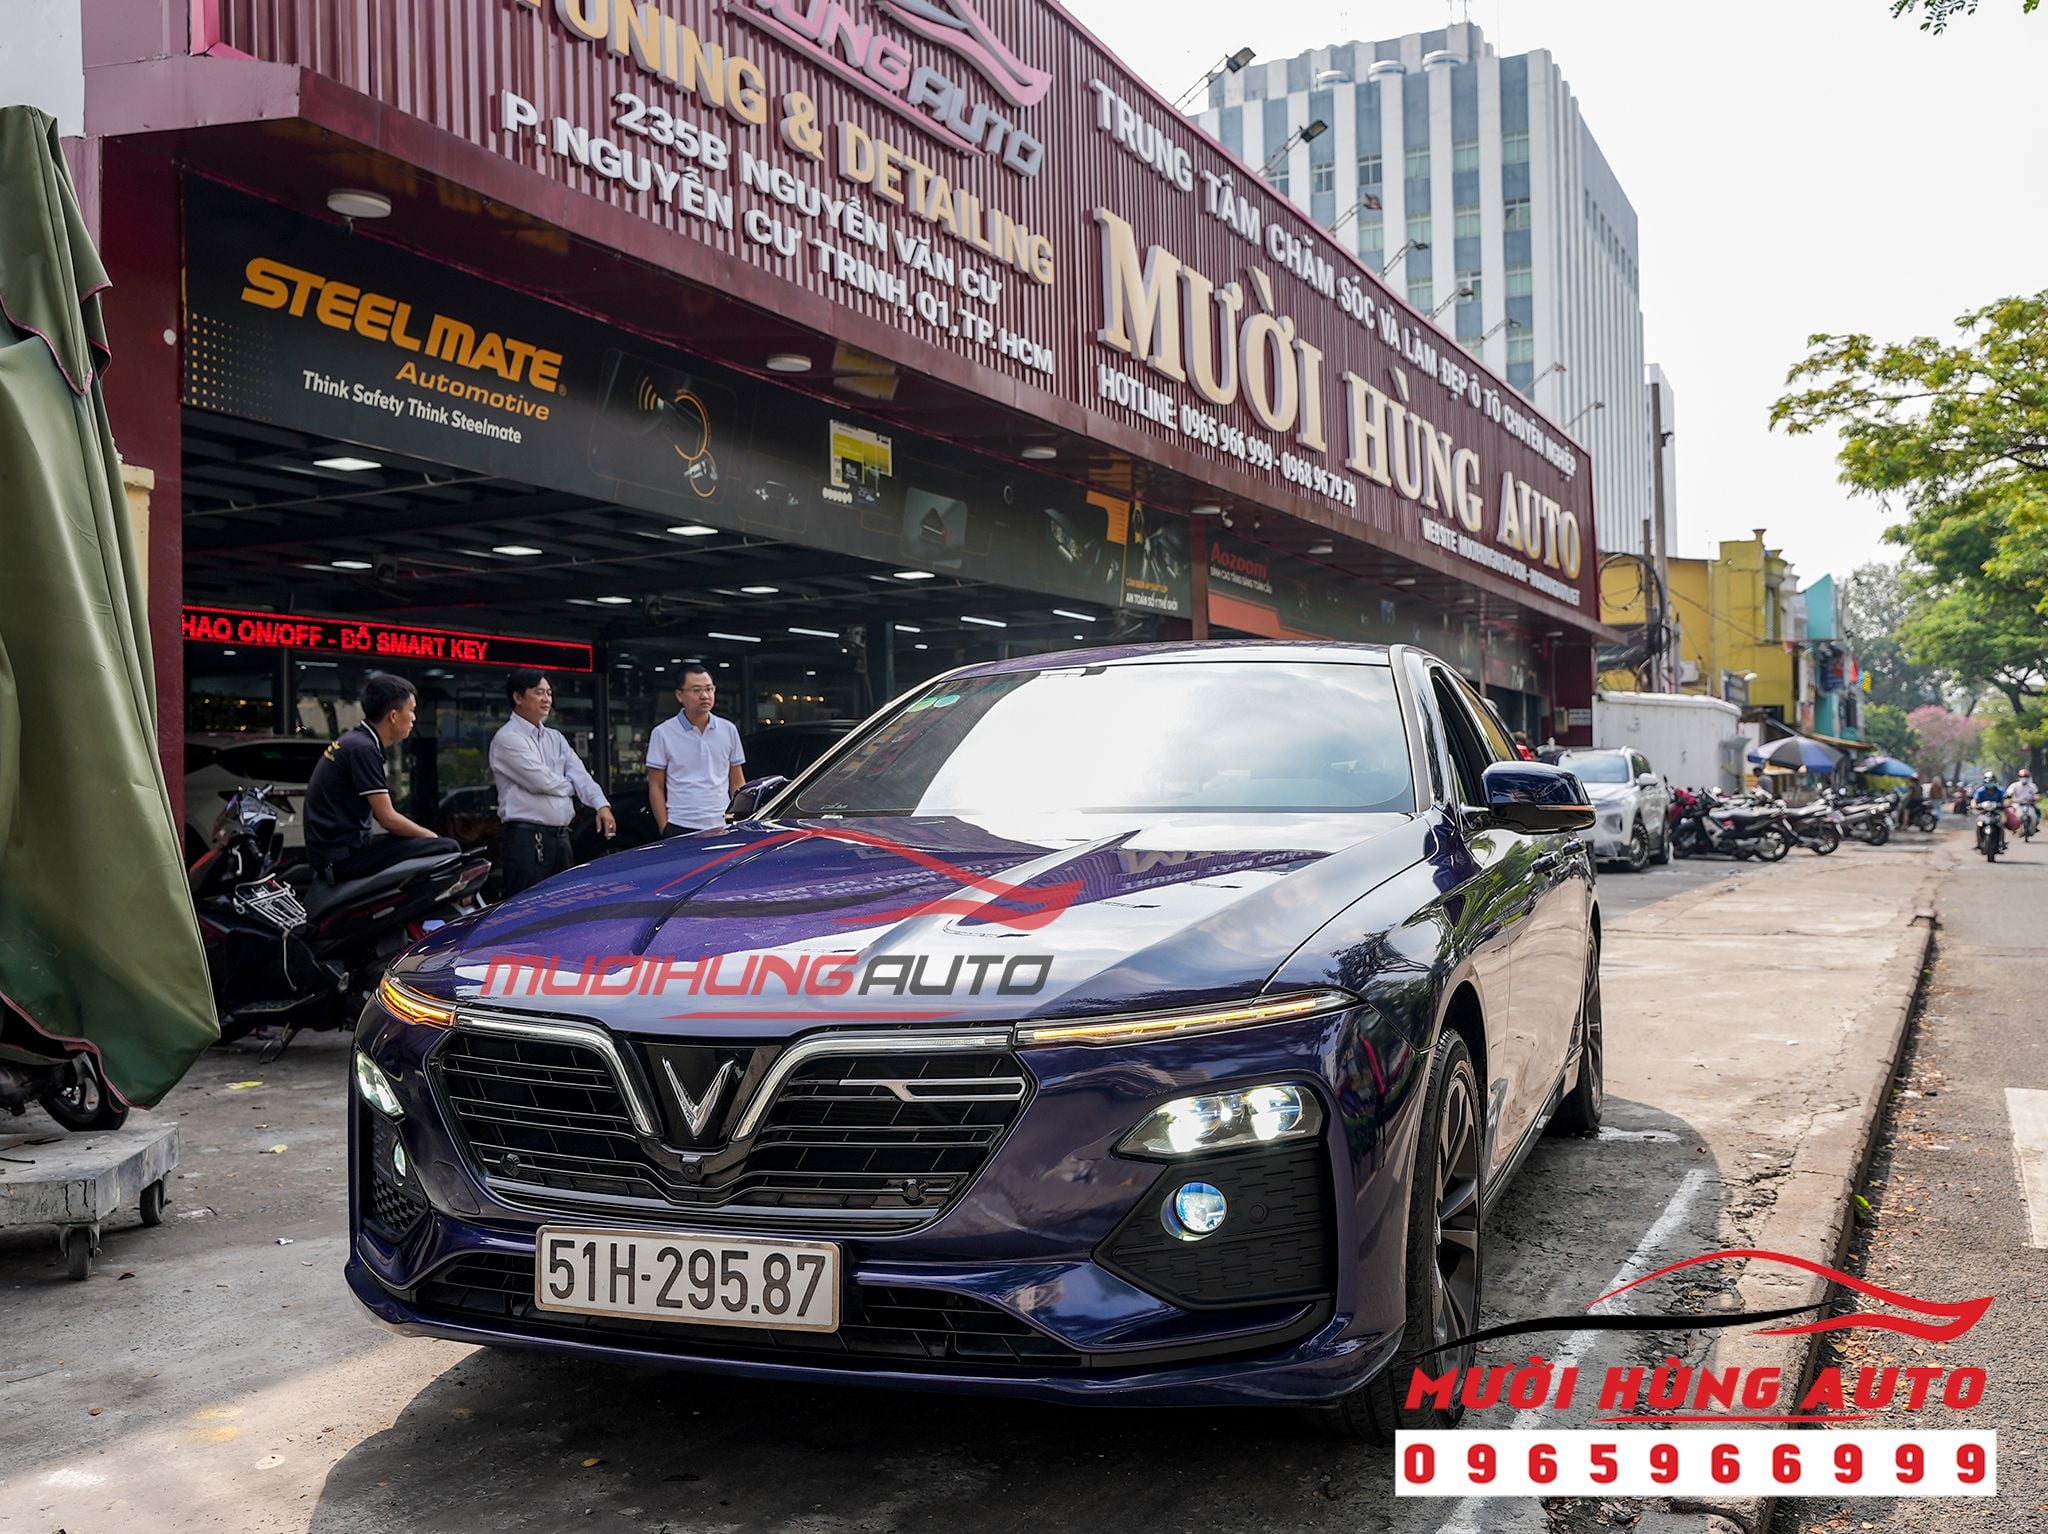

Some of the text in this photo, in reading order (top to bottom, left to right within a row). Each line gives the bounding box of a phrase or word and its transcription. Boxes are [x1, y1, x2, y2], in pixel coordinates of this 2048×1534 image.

[615, 92, 728, 172] 235B
[740, 149, 888, 253] NGUYỄN
[893, 229, 954, 287] VĂN
[783, 91, 825, 161] &
[837, 120, 1054, 284] DETAILING
[744, 208, 802, 257] CƯ
[1090, 79, 1193, 193] TRUNG
[1201, 169, 1261, 246] TÂM
[1265, 223, 1336, 299] CHĂM
[1336, 275, 1375, 330] SÓC
[1377, 306, 1401, 351] VÀ
[1403, 327, 1438, 378] LÀM
[1439, 356, 1468, 400] ĐẸP
[1468, 373, 1482, 409] Ô
[1482, 388, 1501, 424] TÔ
[1502, 404, 1545, 455] CHUYÊN
[241, 256, 563, 393] STEELMATE
[303, 370, 522, 444] Think Safety Think Steelmate
[395, 361, 550, 421] Automotive
[1093, 207, 1581, 579] MƯỜI HÙNG AUTO
[1181, 404, 1218, 448] 0965
[1218, 422, 1245, 460] 966
[1247, 436, 1273, 471] 999
[1281, 451, 1313, 489] 0968
[1211, 543, 1267, 578] Aozoom
[238, 622, 322, 646] ON/OFF
[376, 631, 446, 657] SMART
[449, 638, 488, 661] KEY
[549, 1239, 826, 1318] 51H-295.87
